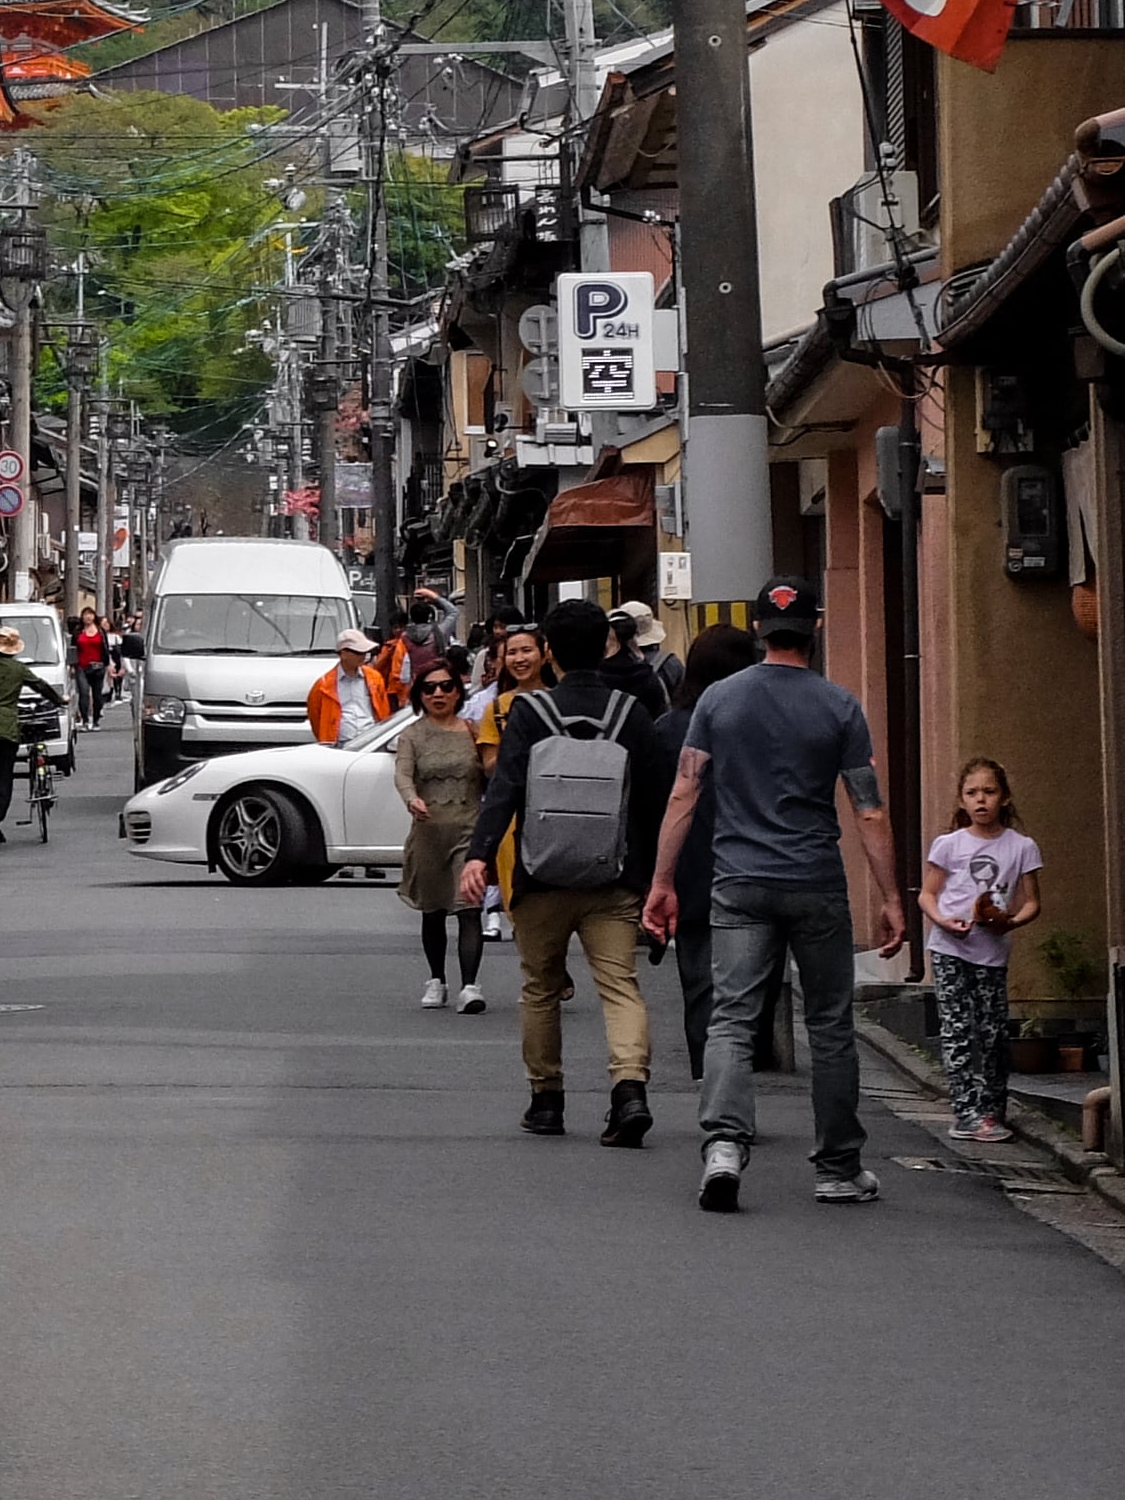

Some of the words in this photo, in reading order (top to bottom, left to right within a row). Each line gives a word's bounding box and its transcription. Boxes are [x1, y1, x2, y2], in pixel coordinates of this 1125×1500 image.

[573, 281, 628, 339] P
[603, 323, 639, 339] 24H
[1, 460, 17, 474] 30
